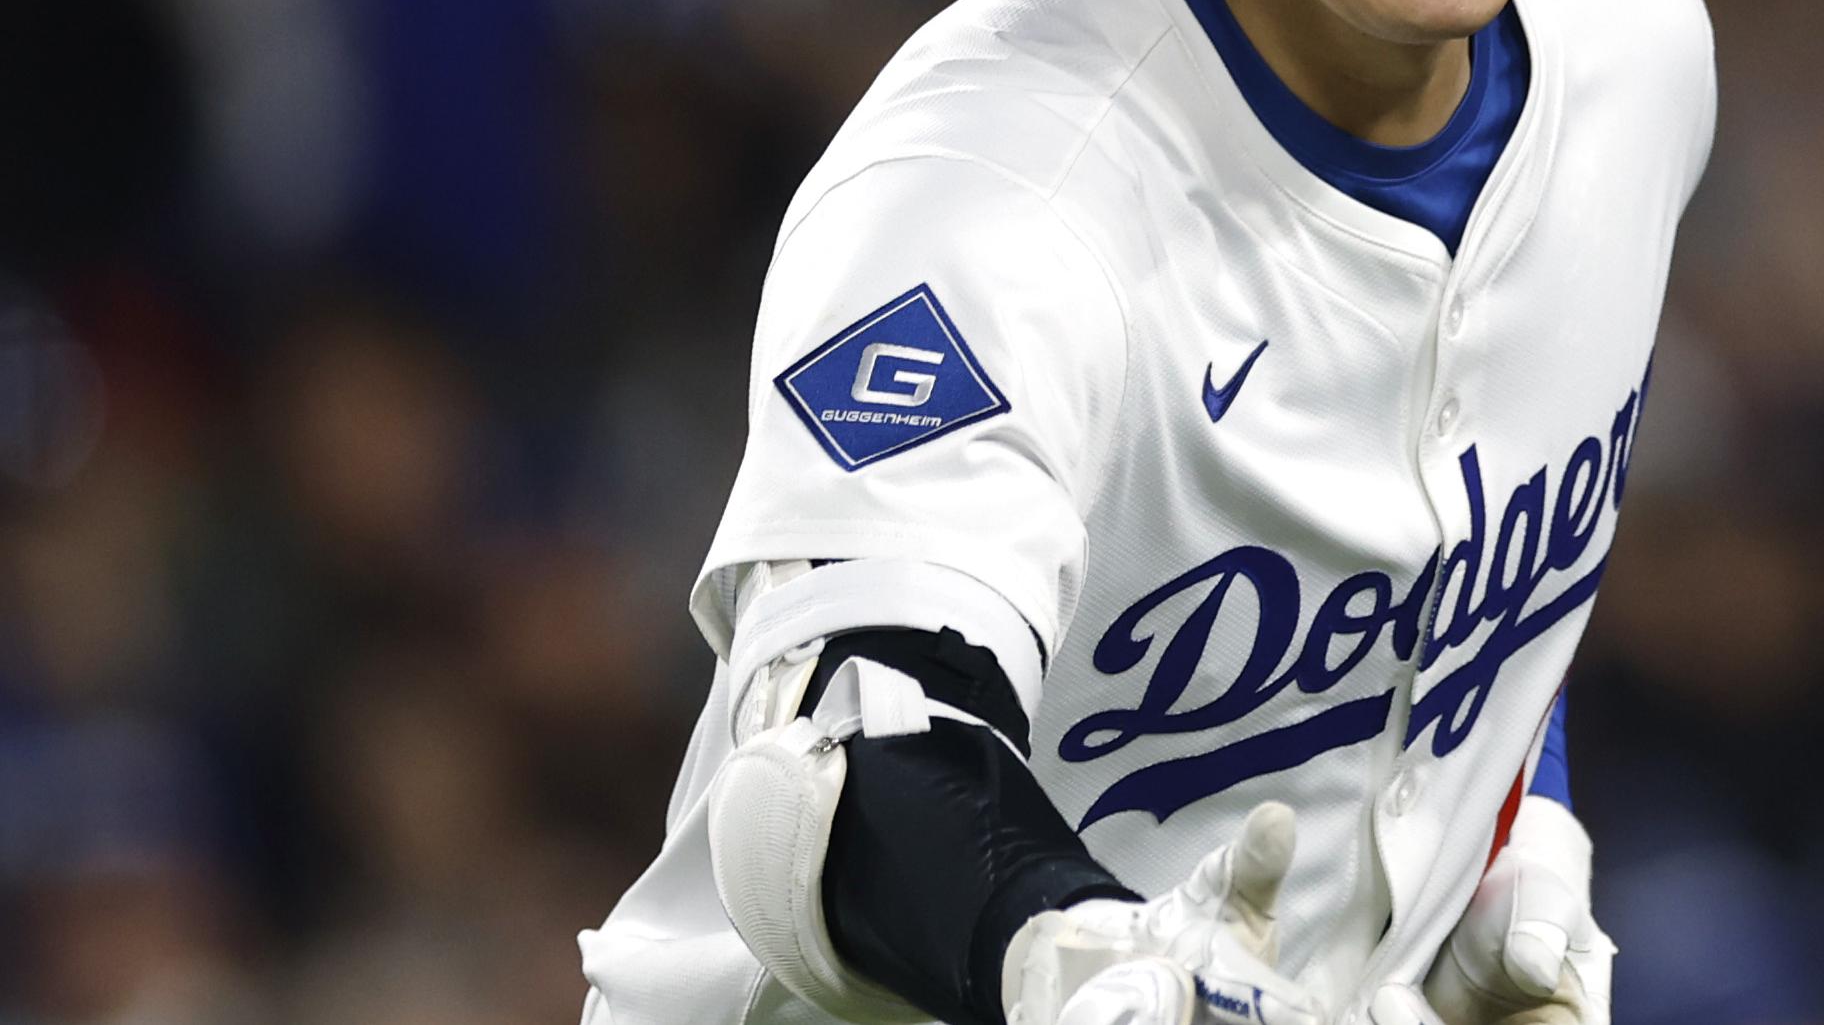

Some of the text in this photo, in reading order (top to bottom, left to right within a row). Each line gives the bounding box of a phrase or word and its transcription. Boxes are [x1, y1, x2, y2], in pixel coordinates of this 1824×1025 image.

[851, 342, 945, 407] G
[820, 408, 942, 428] GUGGENHEIM
[1059, 344, 1655, 762] Dodger
